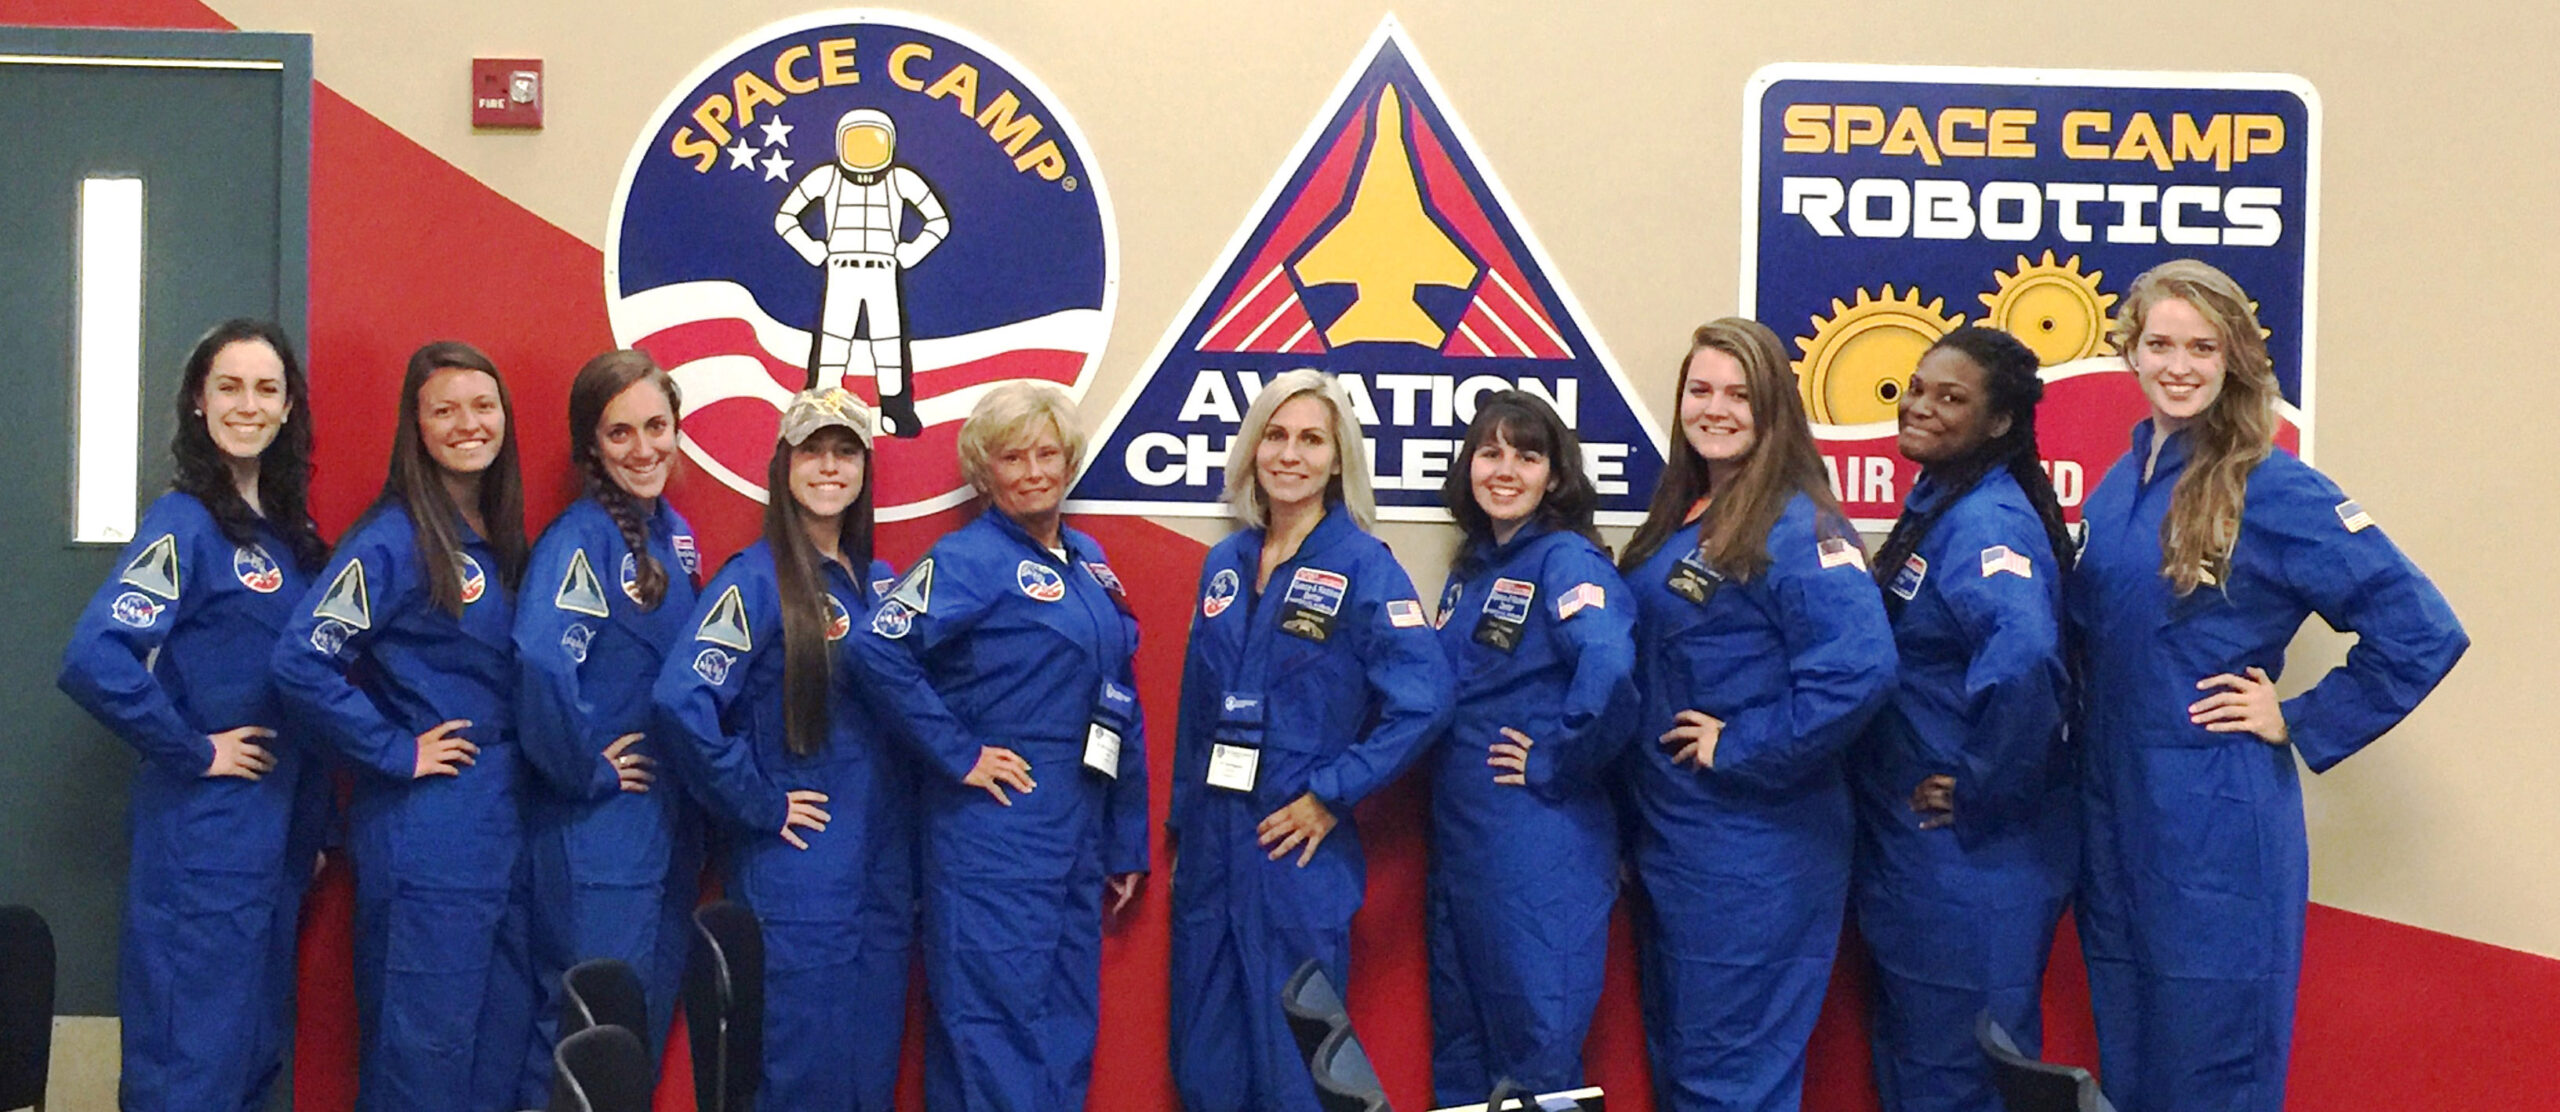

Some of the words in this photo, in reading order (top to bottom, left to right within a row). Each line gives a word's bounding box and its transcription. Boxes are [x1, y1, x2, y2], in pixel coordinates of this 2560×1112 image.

[671, 37, 860, 173] SPACE
[888, 43, 1068, 181] CAMP
[1782, 104, 2037, 165] SPACE
[2062, 111, 2286, 171] CAMP
[1782, 176, 2283, 246] ROBOTICS
